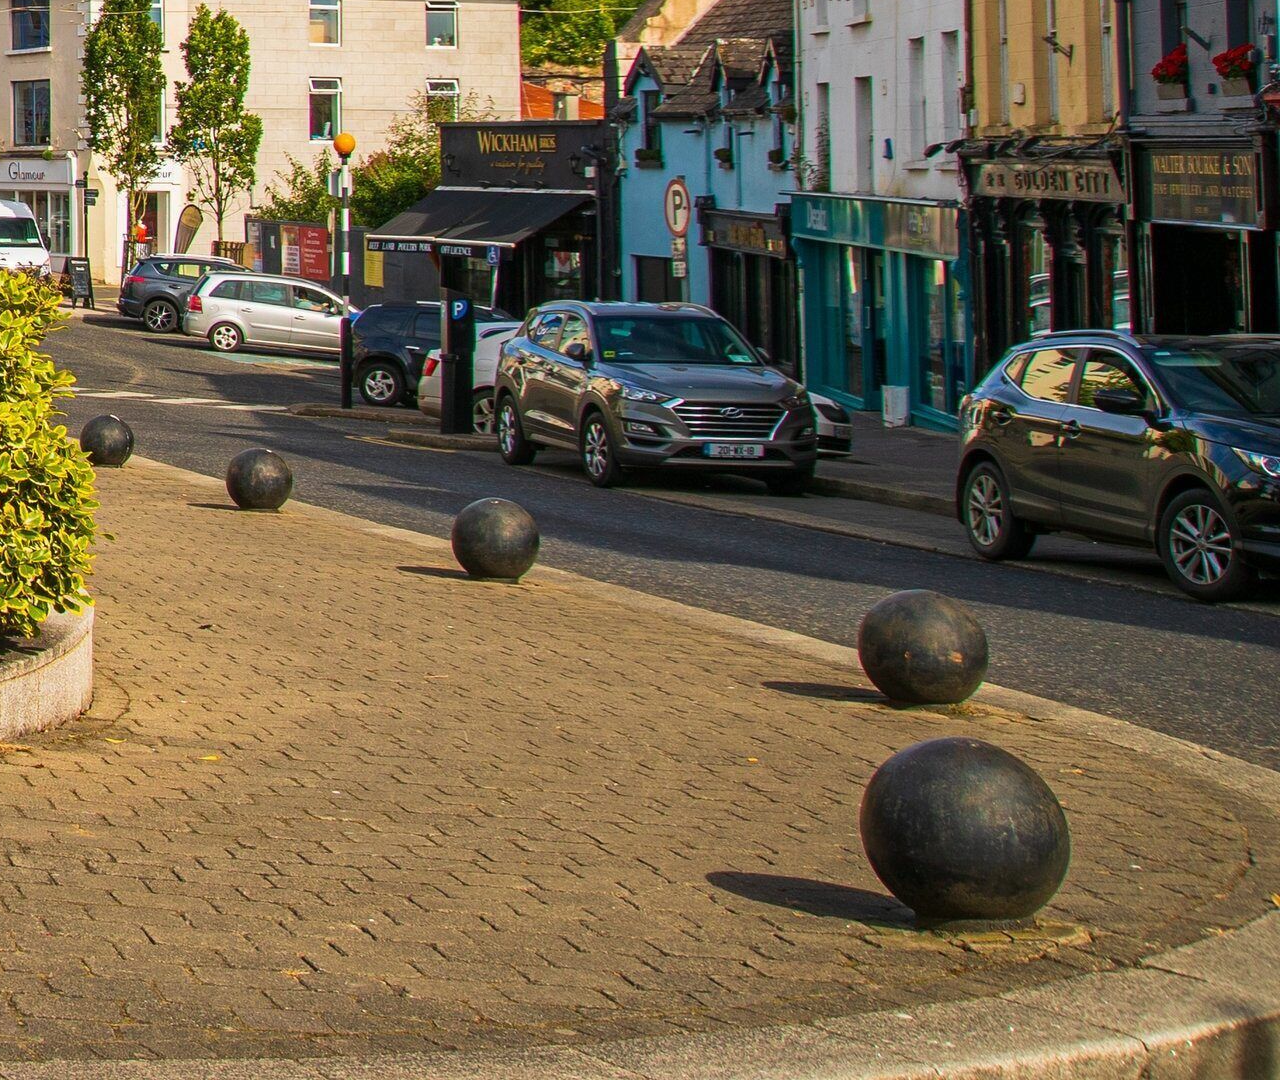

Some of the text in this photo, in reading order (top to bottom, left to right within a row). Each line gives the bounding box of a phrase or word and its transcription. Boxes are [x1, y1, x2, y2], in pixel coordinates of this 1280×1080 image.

[477, 130, 539, 154] WICKHAM
[8, 161, 46, 180] Glamour
[1152, 155, 1252, 176] WALTER BOURKE & SON
[1014, 170, 1068, 192] GOLDEN
[1074, 170, 1110, 194] CITY
[672, 189, 683, 225] P
[454, 302, 464, 316] P
